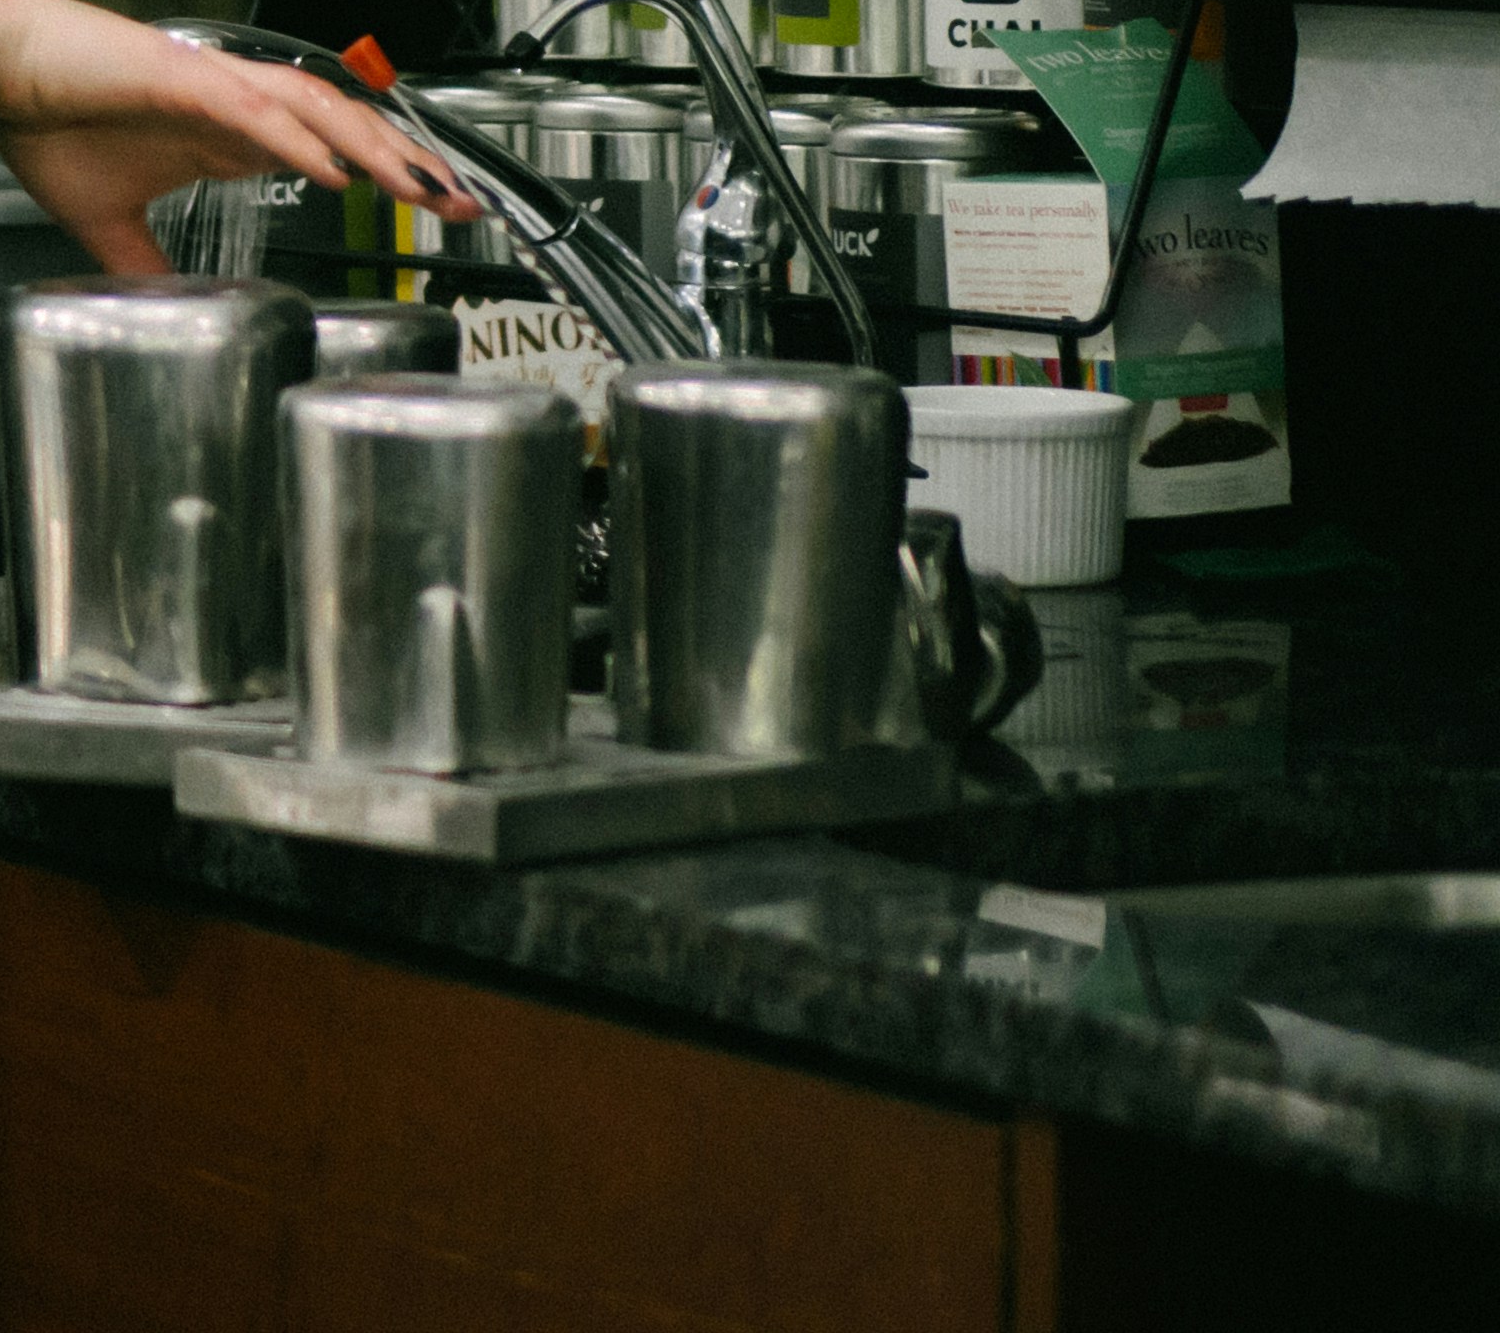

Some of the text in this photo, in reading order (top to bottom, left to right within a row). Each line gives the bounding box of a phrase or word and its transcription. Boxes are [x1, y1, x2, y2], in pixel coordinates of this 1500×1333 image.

[948, 198, 1099, 222] We take tea personally
[1134, 212, 1270, 259] wo leaves
[465, 311, 600, 365] NINO
